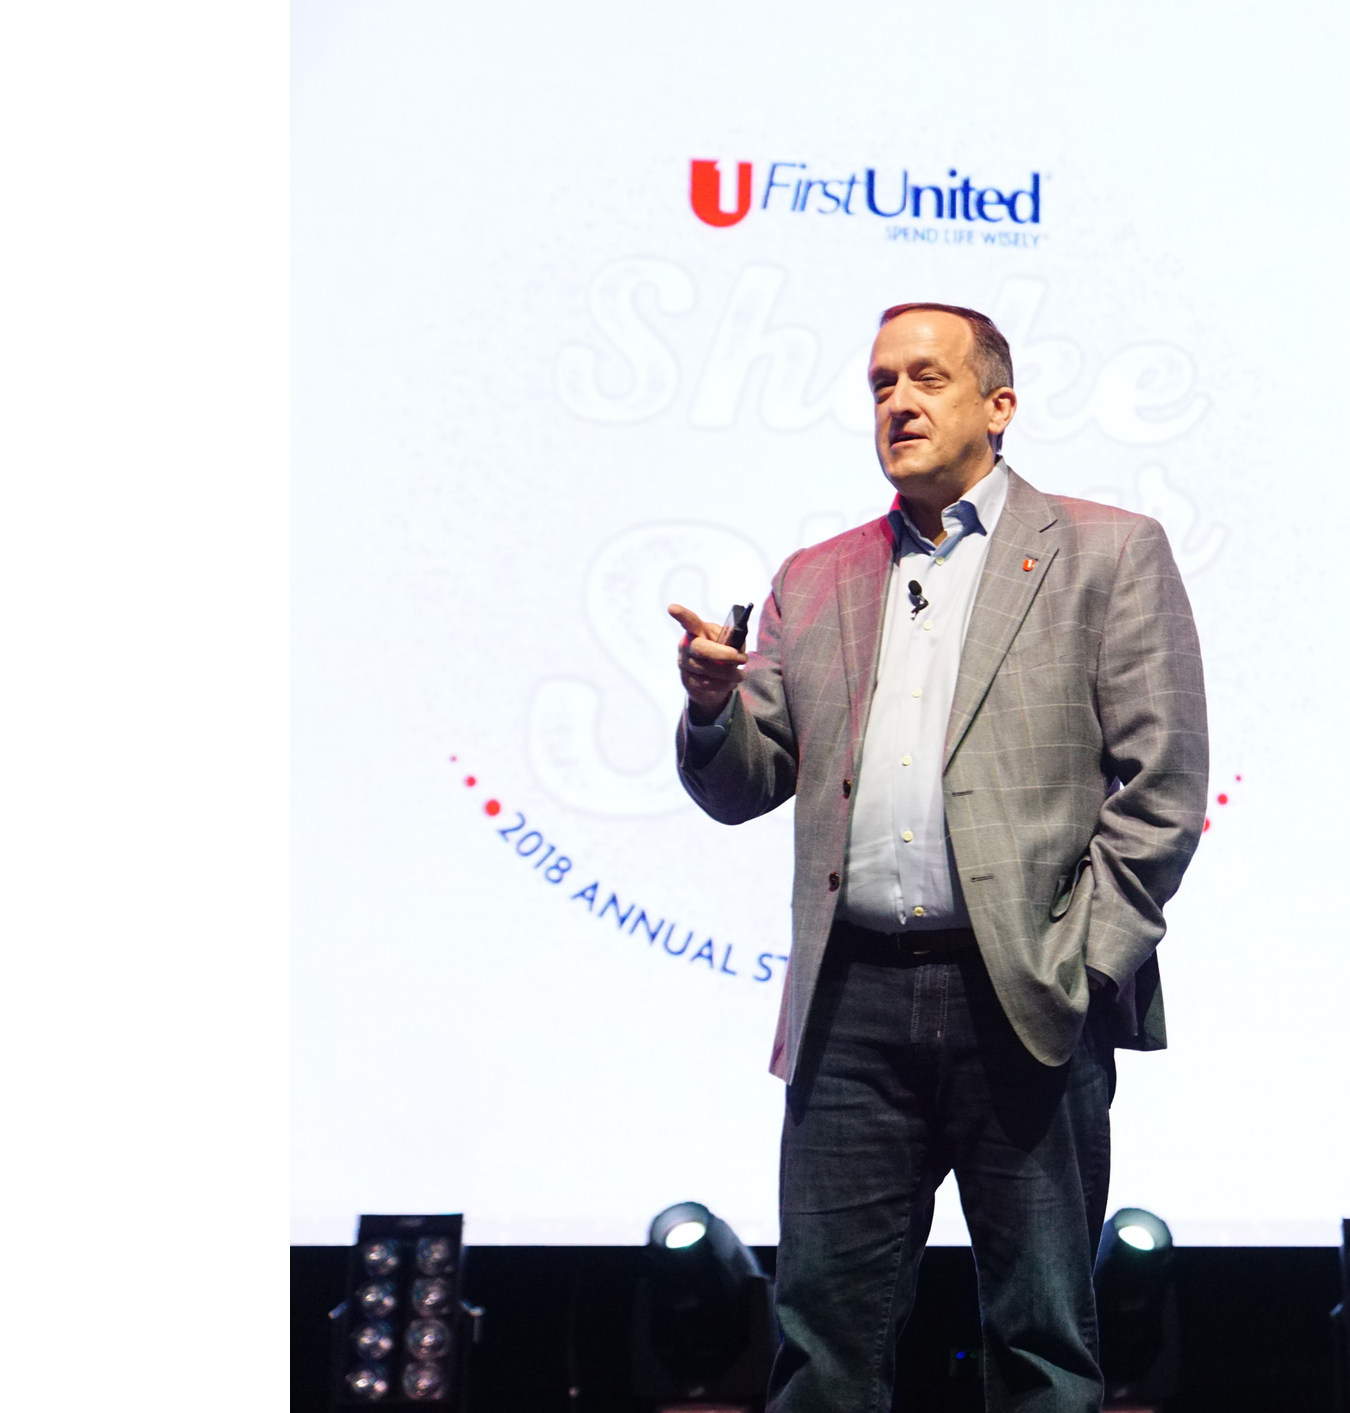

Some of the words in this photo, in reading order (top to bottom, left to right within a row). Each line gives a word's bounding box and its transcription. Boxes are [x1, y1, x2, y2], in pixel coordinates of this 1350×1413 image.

[886, 226, 938, 244] SPEND
[944, 228, 974, 245] LIFE
[981, 230, 1040, 248] WISELY
[498, 811, 572, 884] 2018
[571, 881, 738, 976] ANNUAL
